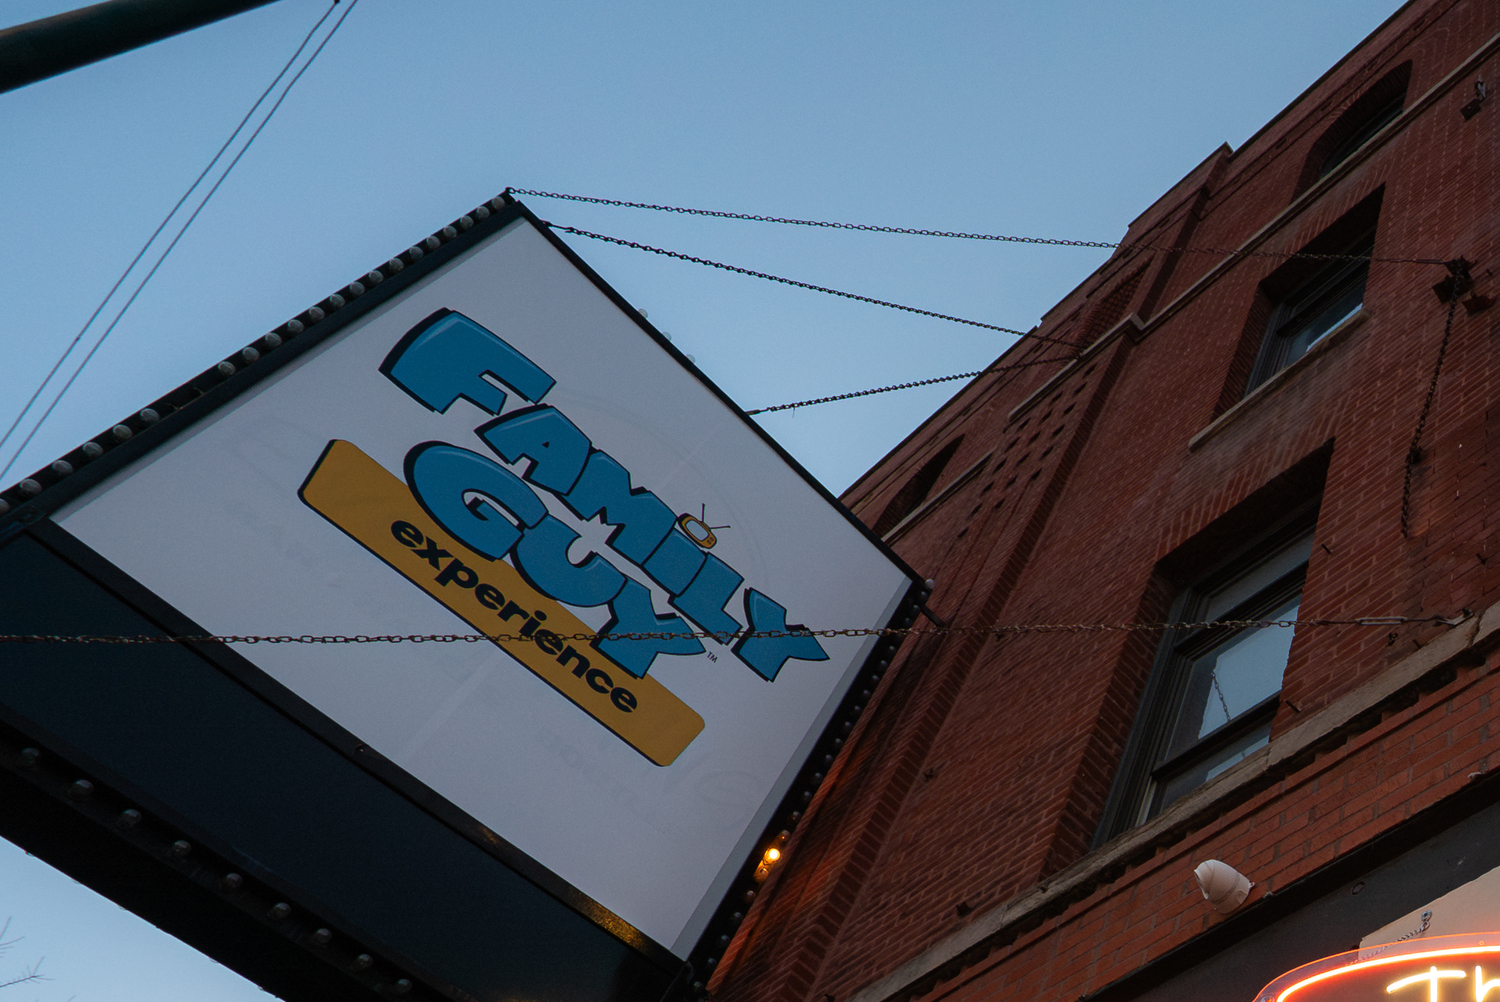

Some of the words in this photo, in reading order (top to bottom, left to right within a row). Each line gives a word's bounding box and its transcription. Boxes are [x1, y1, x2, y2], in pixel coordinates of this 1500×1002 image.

[378, 307, 830, 682] FAMILY
[403, 440, 706, 679] GUY
[391, 519, 638, 713] experience
